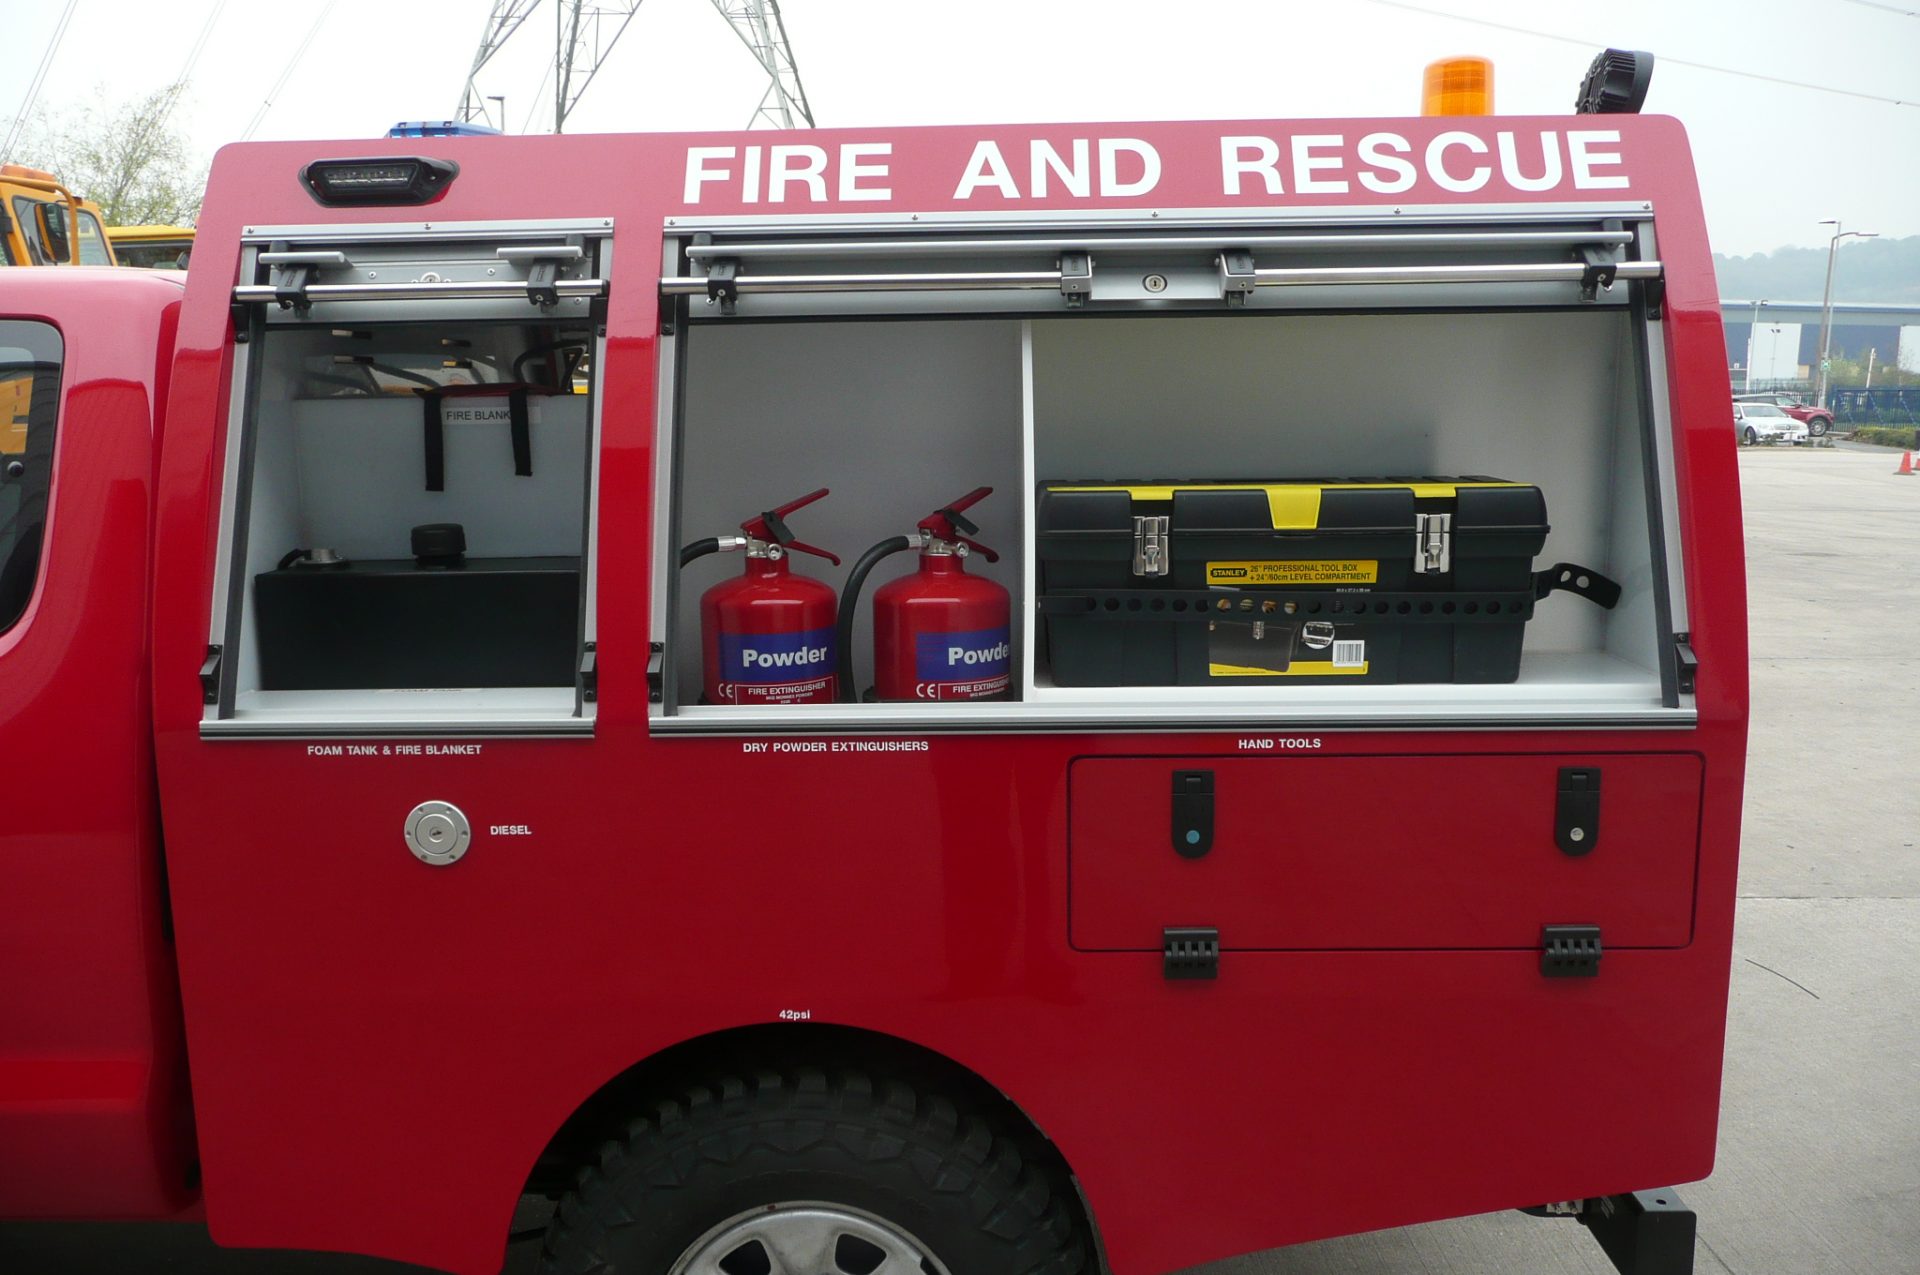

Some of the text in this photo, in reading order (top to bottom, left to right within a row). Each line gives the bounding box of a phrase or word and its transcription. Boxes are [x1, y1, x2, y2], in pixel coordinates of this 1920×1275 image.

[683, 129, 1631, 204] FIRE AND RESCUE
[446, 410, 511, 420] FIRE BLANK
[1212, 569, 1246, 577] STANLEY
[1263, 564, 1319, 572] PROFESSIONAL
[1320, 564, 1340, 572] TOOL
[1342, 563, 1358, 572] BOX
[1290, 573, 1313, 581] LEVEL
[1314, 572, 1371, 581] COMPARTMENT
[742, 646, 828, 668] Powder
[948, 641, 1010, 666] Powde
[748, 681, 826, 696] FIRE EXTINGUISHER
[952, 685, 972, 694] FIRE
[743, 741, 929, 753] DRY POWDER EXTINGUISHERS
[1238, 738, 1322, 749] HAND TOOLS
[307, 744, 482, 756] FOAM TANK & FIRE BLANKET
[490, 825, 532, 835] DIESEL
[779, 1009, 811, 1021] 42psi
